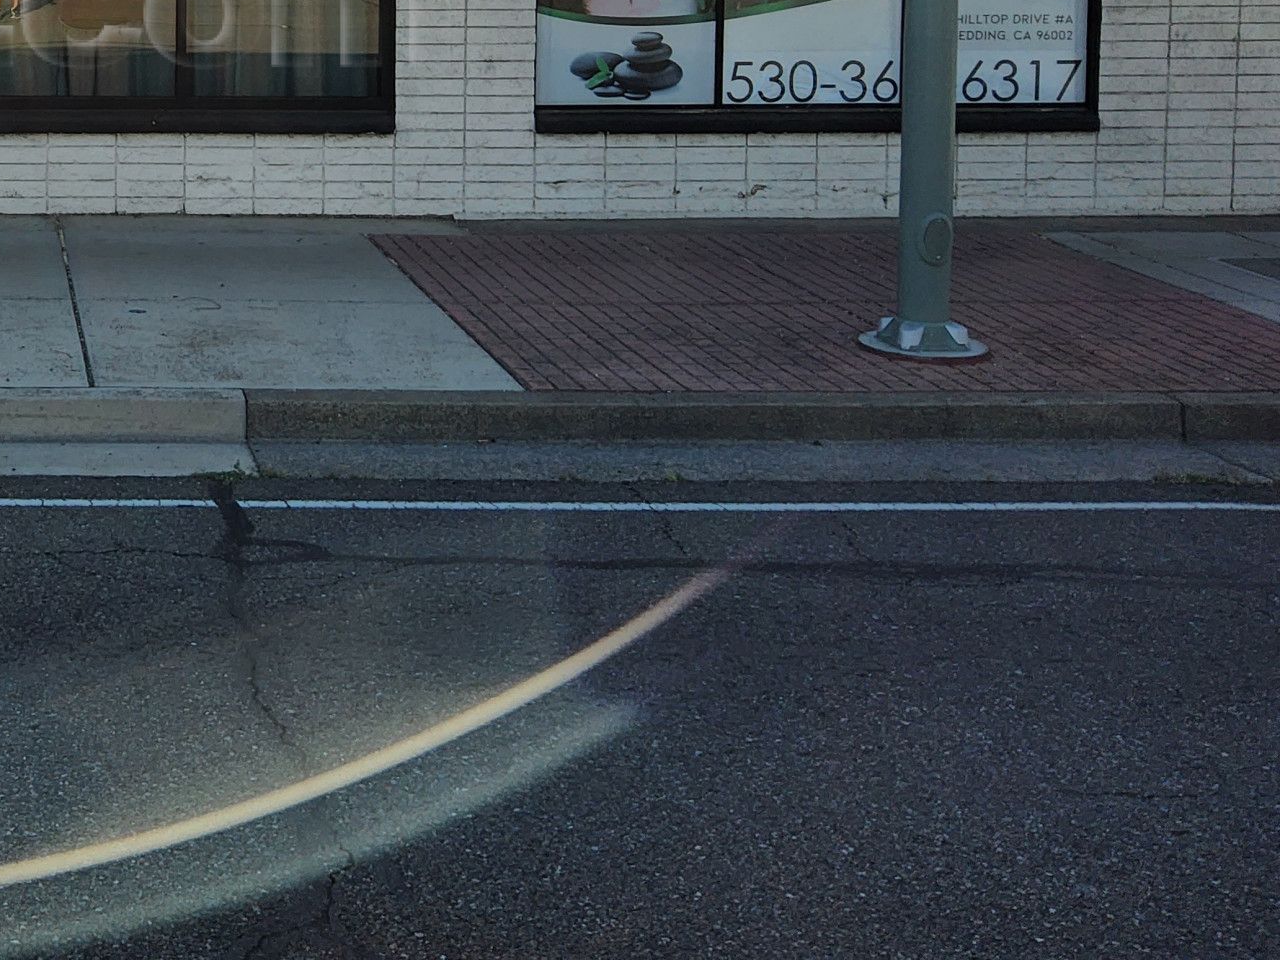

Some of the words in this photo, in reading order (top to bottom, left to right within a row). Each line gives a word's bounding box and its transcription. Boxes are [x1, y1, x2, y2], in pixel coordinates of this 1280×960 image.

[1013, 14, 1050, 25] DRIVE
[1054, 14, 1073, 25] #A
[958, 30, 1009, 41] EDDING,
[1014, 30, 1031, 41] CA
[1037, 30, 1073, 41] 96002
